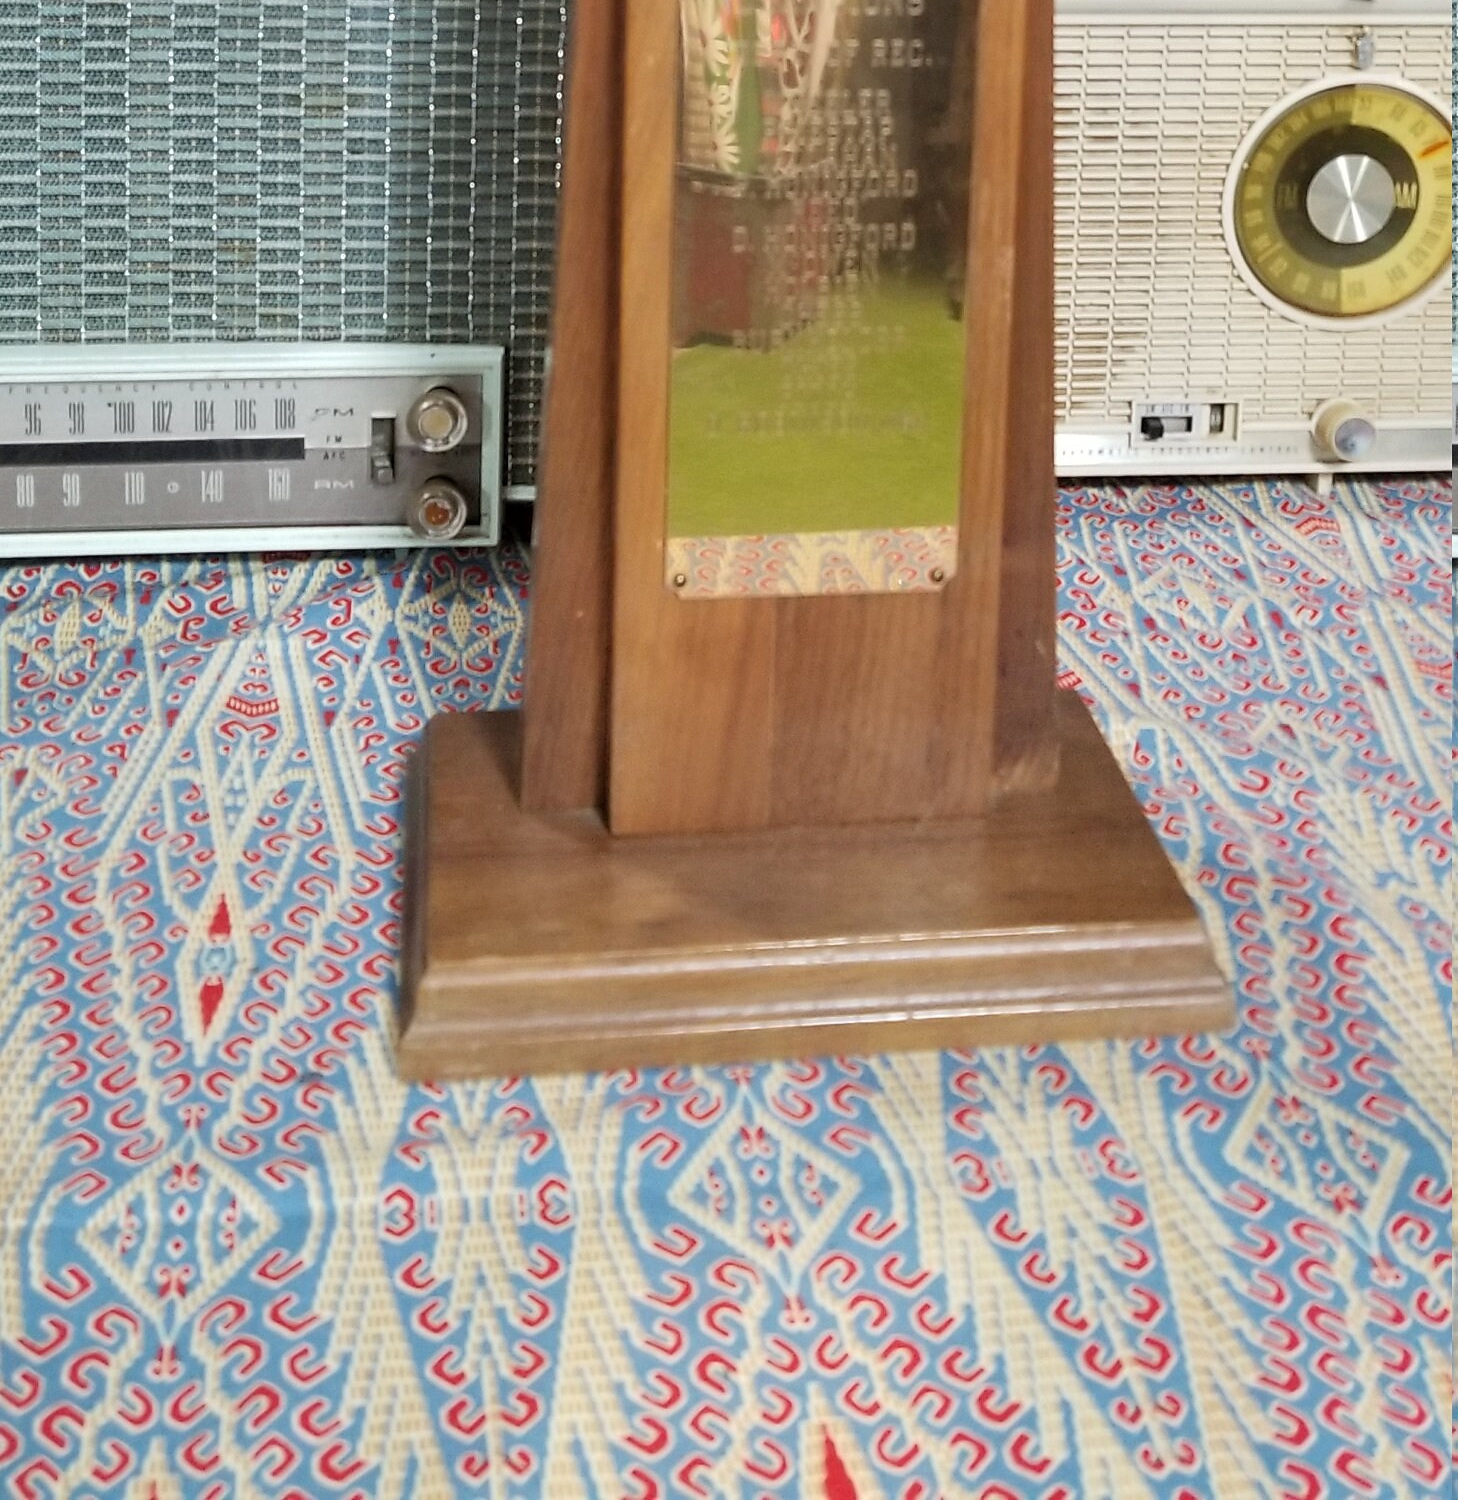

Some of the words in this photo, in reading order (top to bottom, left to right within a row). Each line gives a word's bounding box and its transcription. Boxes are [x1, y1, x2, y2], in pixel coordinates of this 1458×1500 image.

[24, 402, 42, 436] 96
[68, 401, 85, 435] 98
[113, 400, 135, 434] 100
[152, 400, 173, 433] 102
[194, 399, 215, 432] 104
[234, 398, 257, 431] 106
[274, 397, 296, 430] 108
[62, 472, 80, 507] 90
[124, 470, 146, 505] 110
[201, 469, 224, 503] 140
[268, 467, 291, 502] 160
